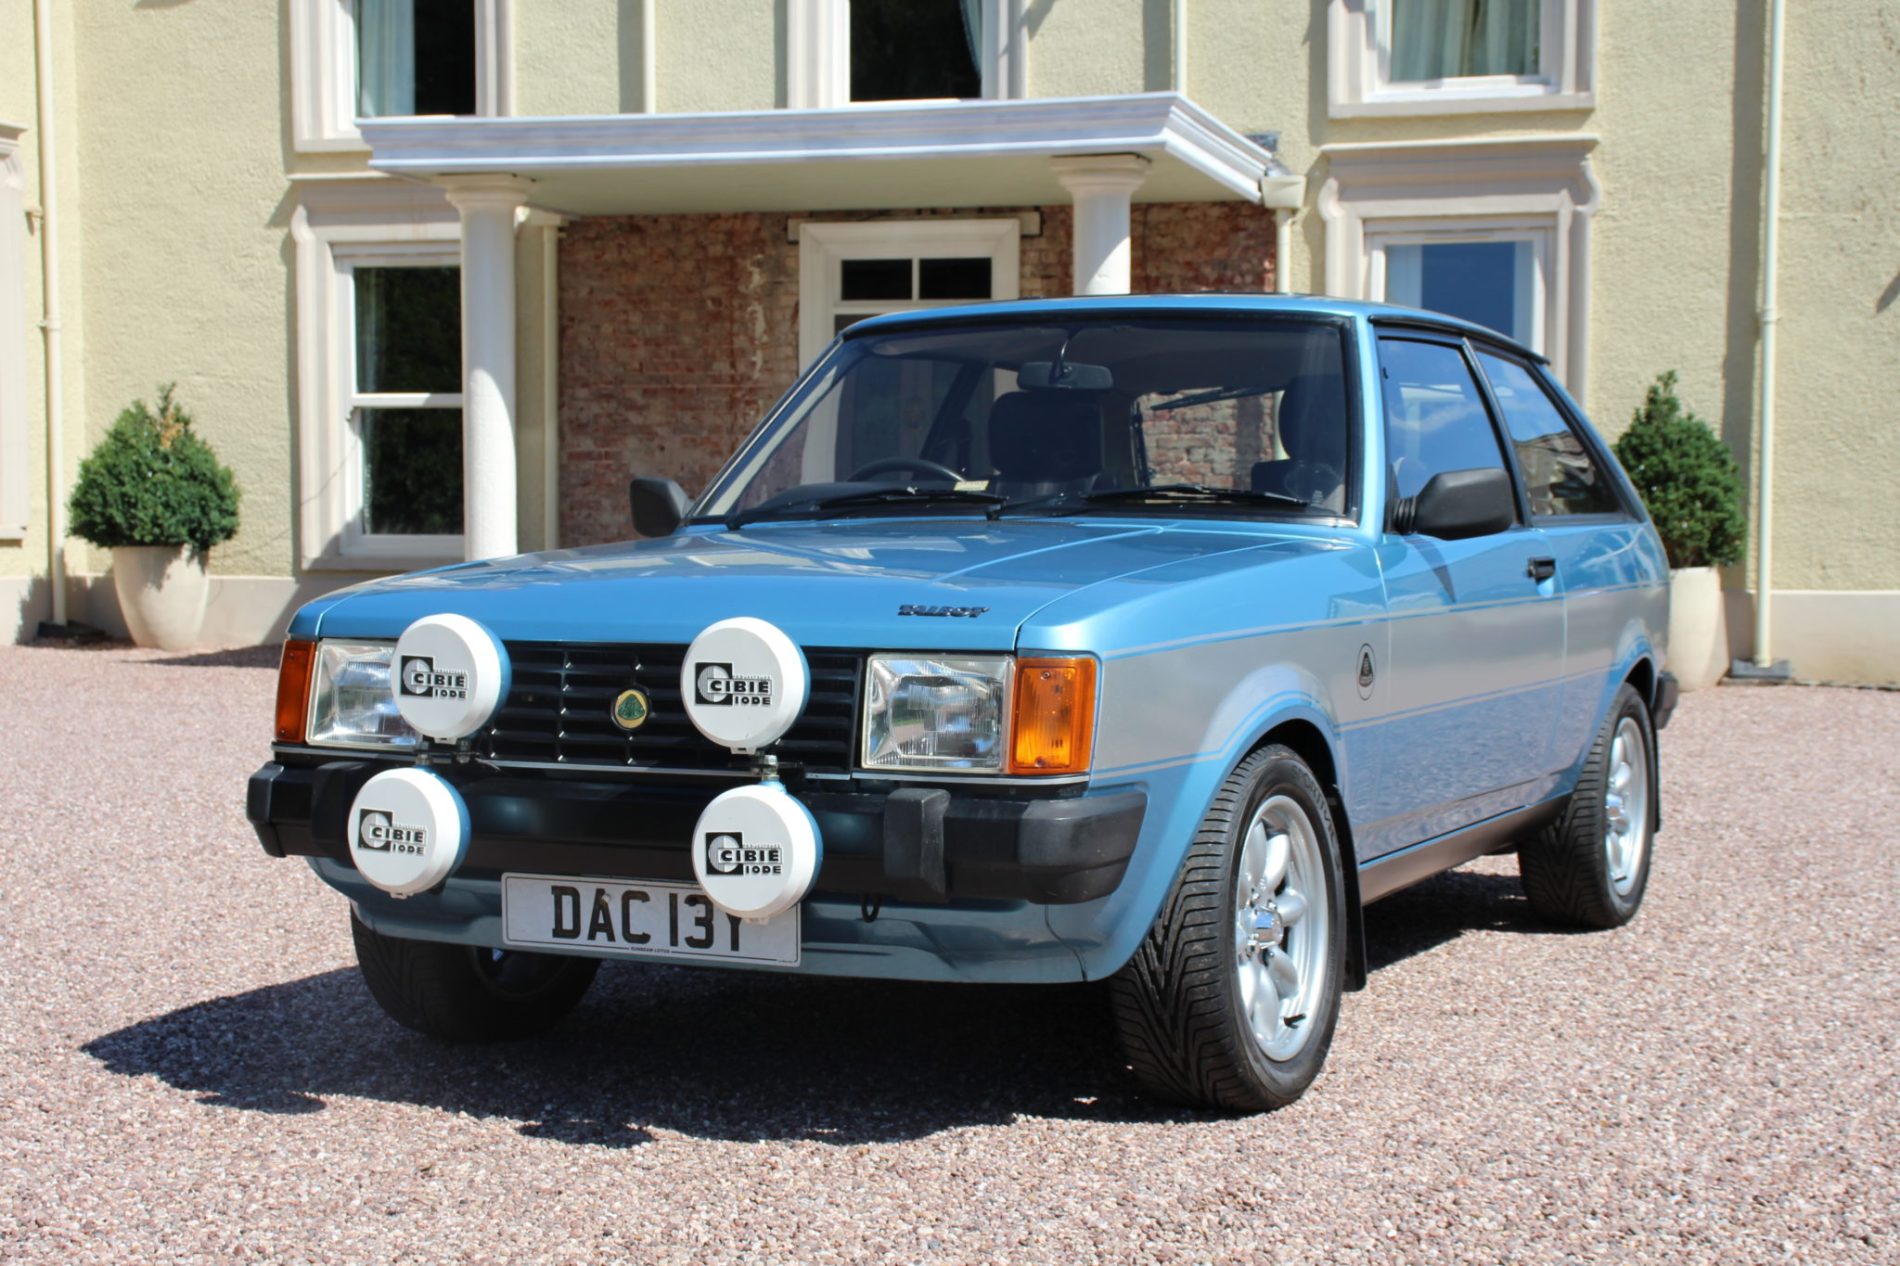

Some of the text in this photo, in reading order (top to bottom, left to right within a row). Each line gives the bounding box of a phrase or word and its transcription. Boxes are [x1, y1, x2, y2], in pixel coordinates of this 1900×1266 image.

[413, 673, 465, 687] CIBIE
[710, 680, 769, 693] CIBIE
[435, 689, 466, 699] IODE
[735, 696, 771, 705] IODE
[372, 827, 424, 843] CIBIE
[393, 843, 424, 854] IODE
[720, 849, 779, 862] CIBIE
[746, 865, 782, 874] IODE
[551, 885, 742, 951] DAC 13Y
